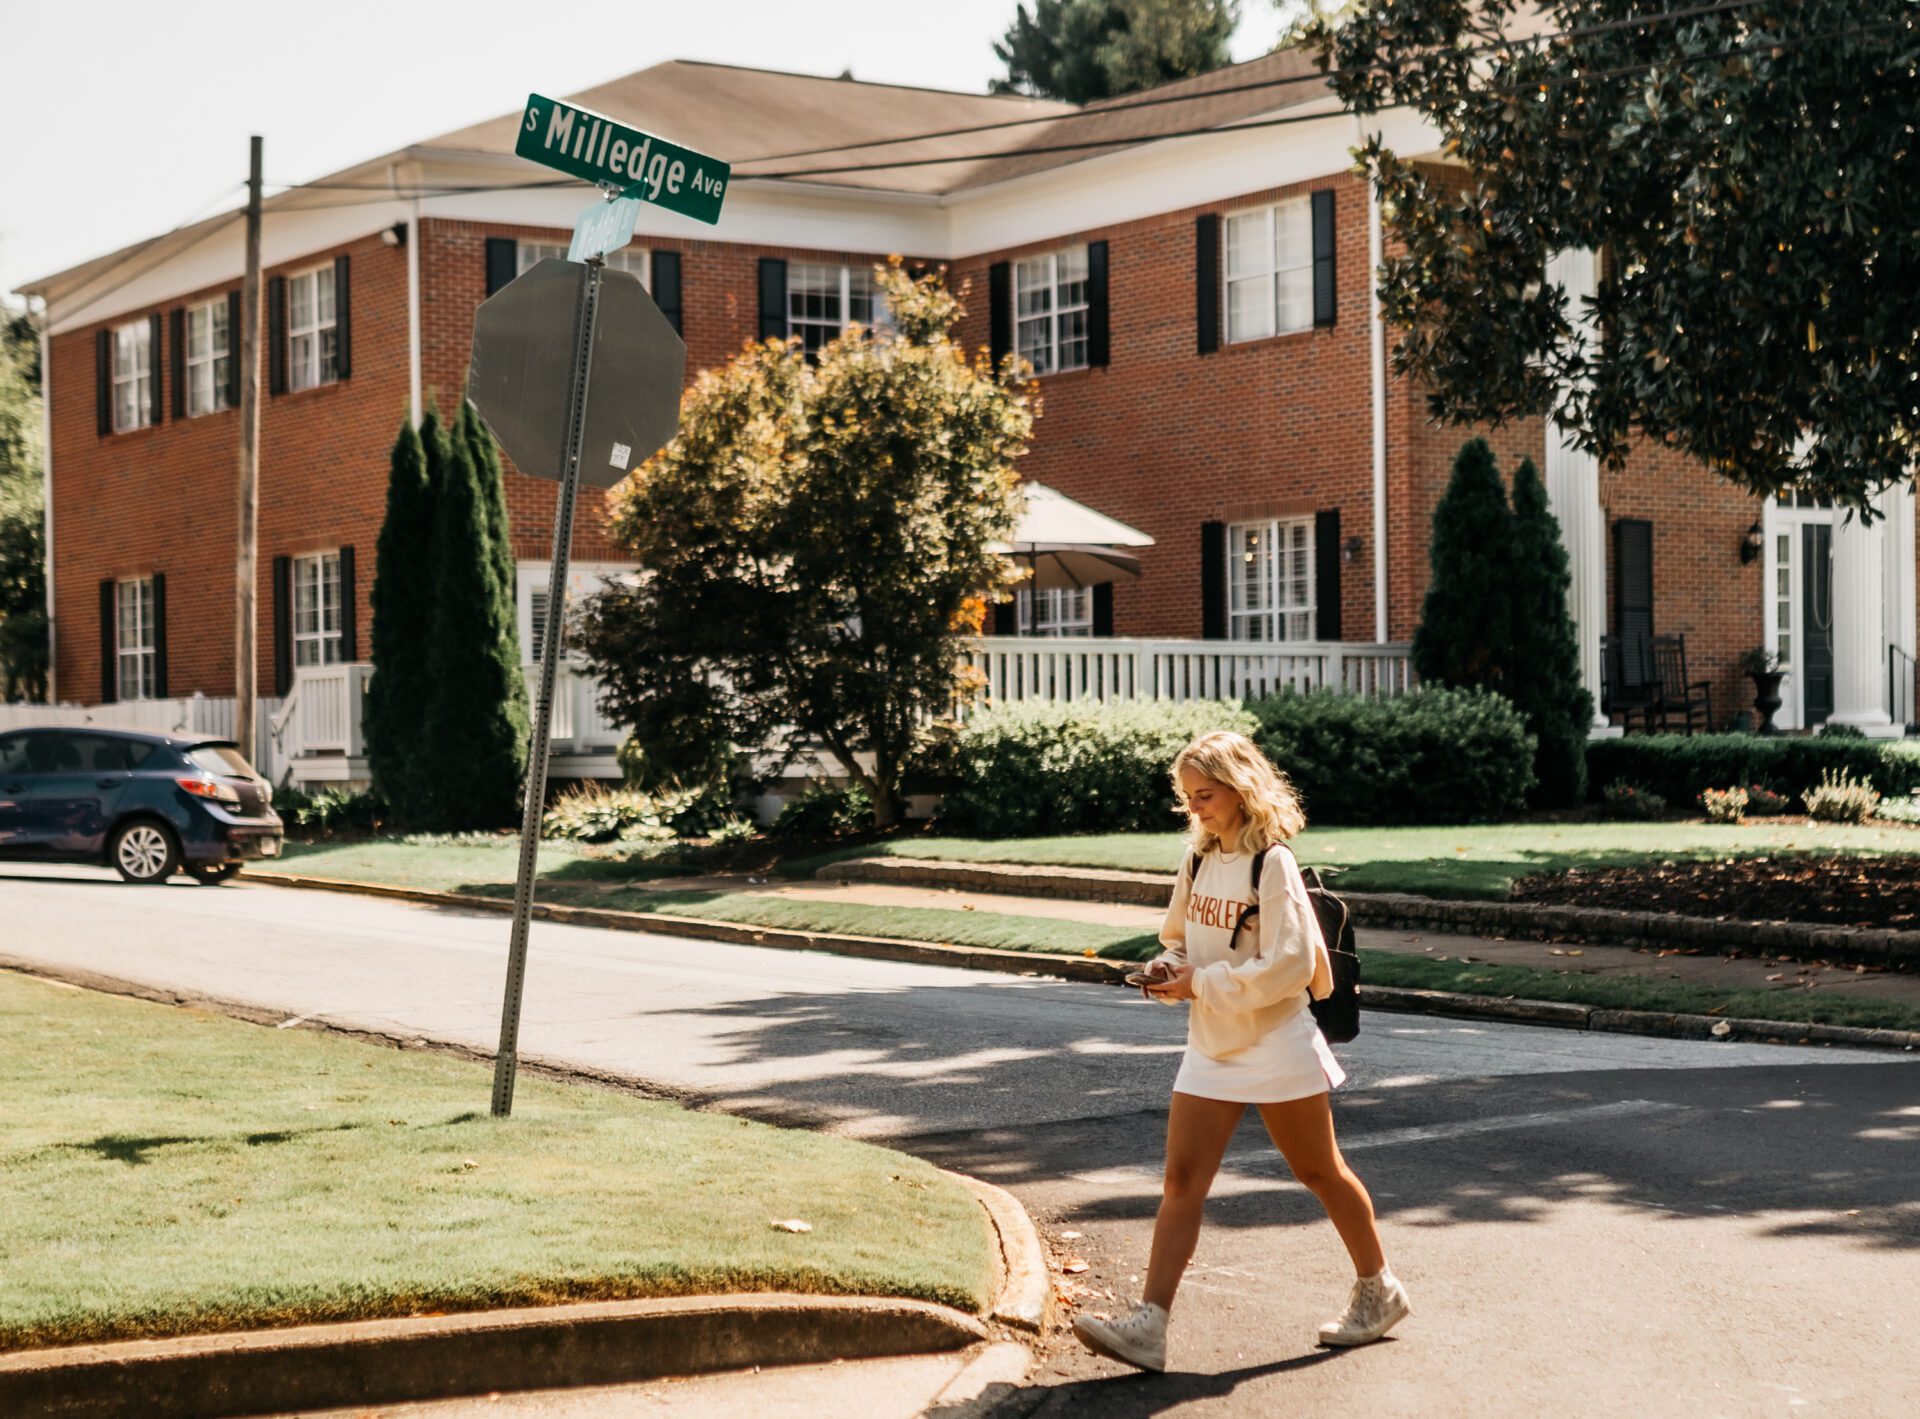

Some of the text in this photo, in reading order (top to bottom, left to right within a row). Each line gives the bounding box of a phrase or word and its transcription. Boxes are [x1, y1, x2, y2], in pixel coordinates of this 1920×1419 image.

[526, 104, 723, 200] S Milledge Ave
